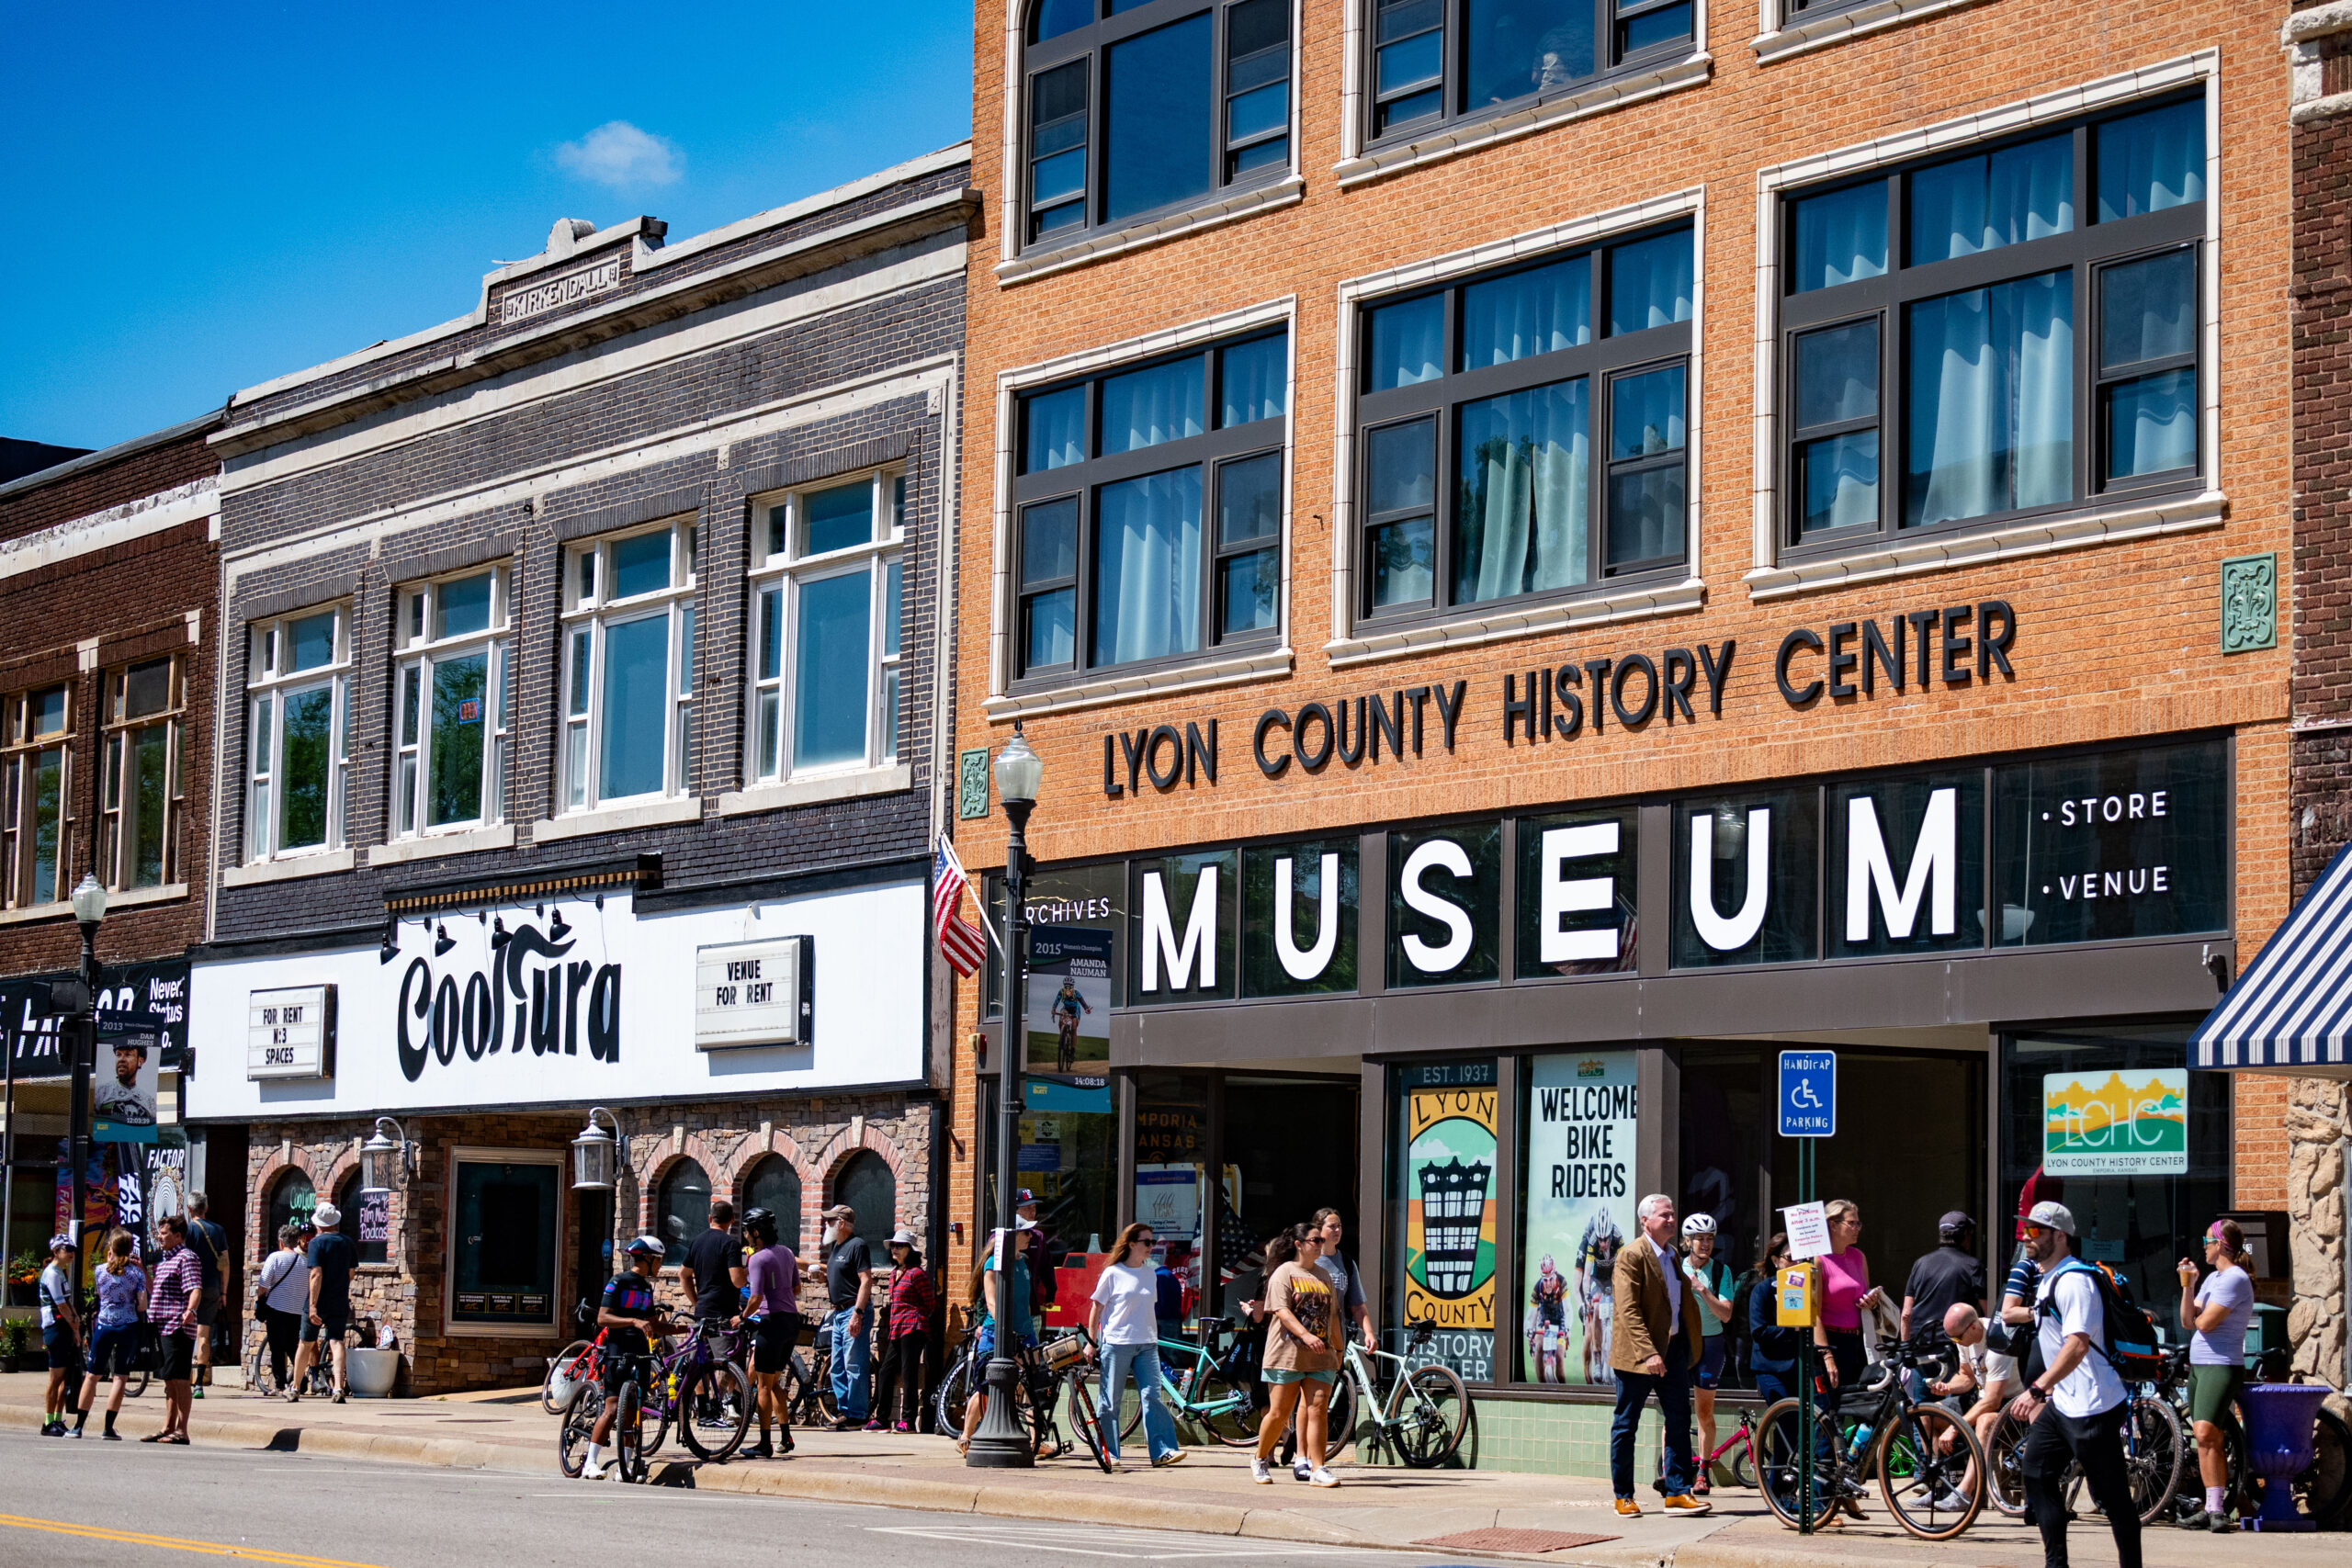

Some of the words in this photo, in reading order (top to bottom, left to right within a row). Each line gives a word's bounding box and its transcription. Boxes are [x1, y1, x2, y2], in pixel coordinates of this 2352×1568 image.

[513, 265, 608, 317] KIRKENDALL
[1104, 718, 1217, 795] LYON
[1254, 681, 1467, 774] COUNTY
[1503, 639, 1736, 740] HISTORY
[1775, 600, 2016, 703] CENTER
[2062, 791, 2167, 826] STORE
[1141, 788, 1956, 992] MUSEUM
[2060, 866, 2168, 900] VENUE
[1025, 897, 1109, 925] RCHIVES
[1035, 942, 1061, 954] 2015
[728, 960, 761, 981] VENUE
[1069, 958, 1107, 968] AMANDA
[1069, 967, 1107, 977] NAUMAN
[149, 977, 184, 1000] Never.
[717, 986, 737, 1006] FOR
[746, 982, 773, 1003] RENT
[103, 1021, 123, 1031] 2013
[263, 1008, 277, 1025] FOR
[283, 1006, 303, 1023] RENT
[266, 1047, 294, 1065] SPACES
[1074, 1077, 1105, 1086] 14:08:18
[1423, 1066, 1454, 1083] EST.
[1460, 1066, 1488, 1082] 1937
[1414, 1089, 1496, 1126] LYON
[1137, 1111, 1197, 1129] MPORIA
[1786, 1116, 1828, 1129] PARKING
[2065, 1098, 2164, 1146] LCHC
[1137, 1133, 1196, 1149] ANSAS
[1566, 1124, 1613, 1159] BIKE
[147, 1148, 185, 1169] FACTOR
[2047, 1158, 2068, 1168] LYON
[2072, 1157, 2106, 1168] COUNTY
[2109, 1156, 2147, 1167] HISTORY
[2150, 1156, 2185, 1166] CENTER
[1551, 1163, 1626, 1198] RIDERS
[360, 1221, 390, 1240] Podcas
[1406, 1290, 1496, 1323] COUNTY
